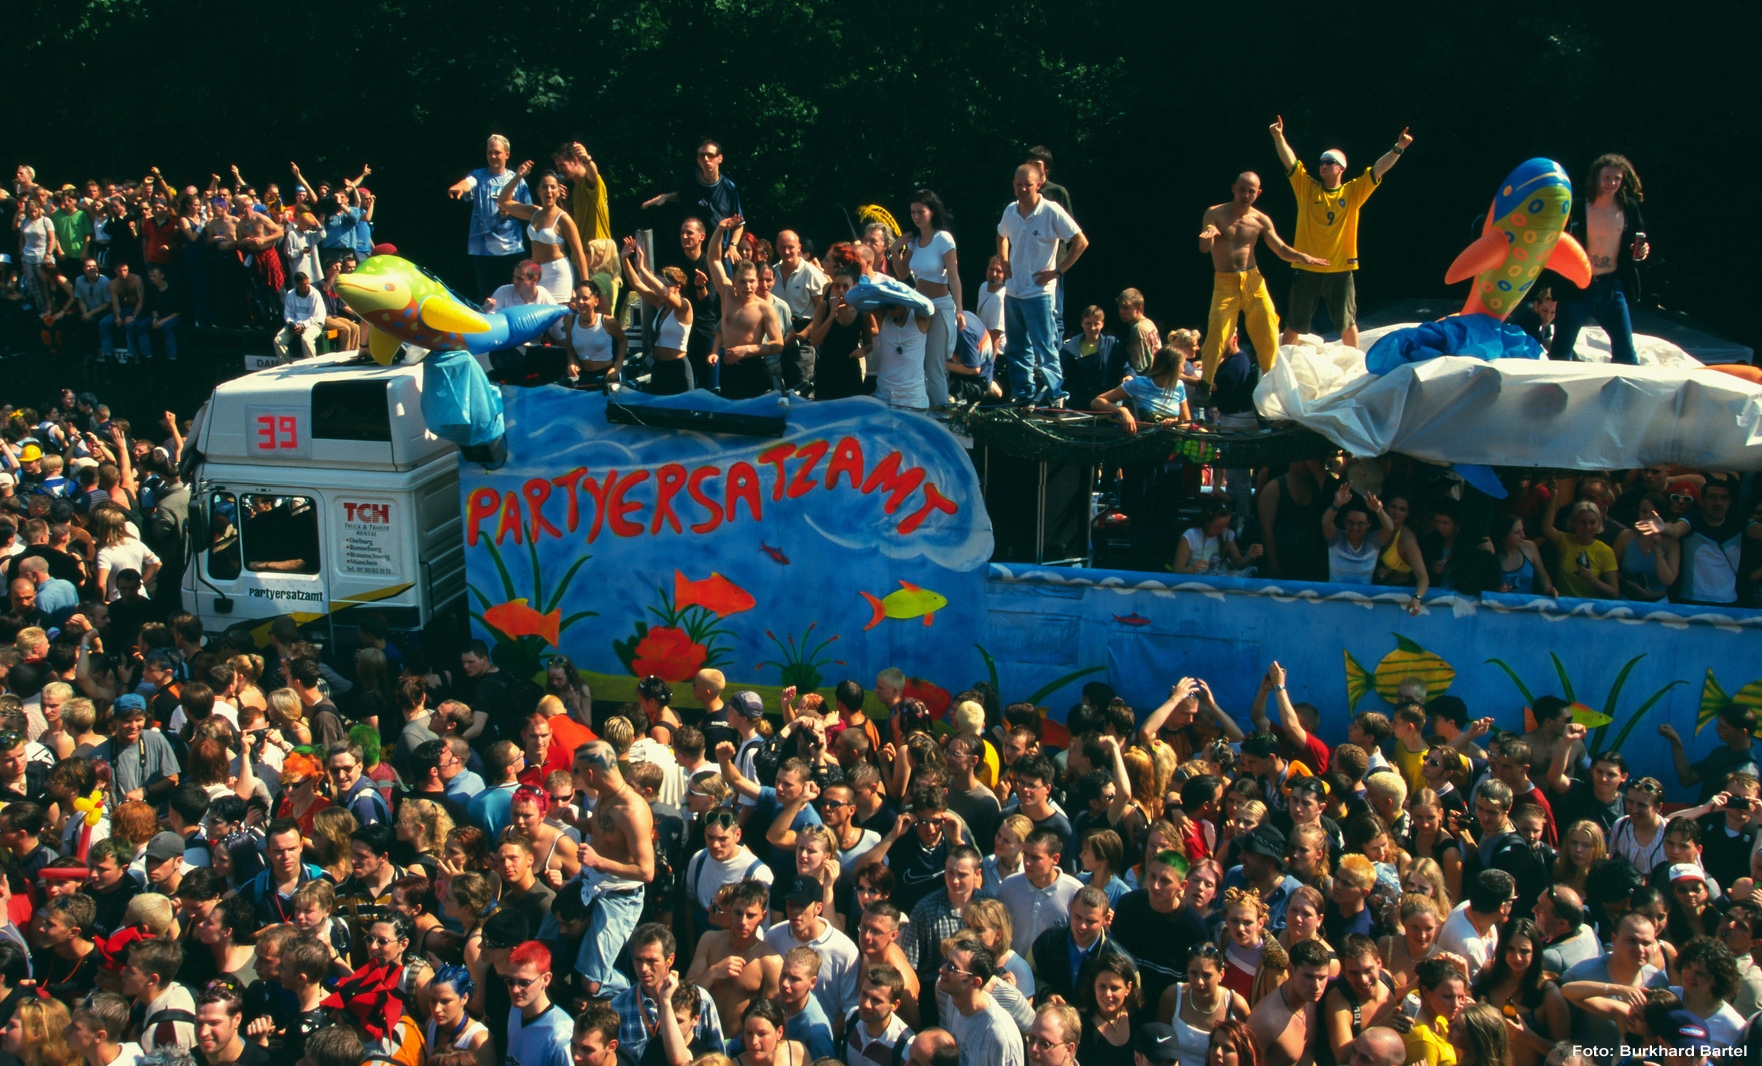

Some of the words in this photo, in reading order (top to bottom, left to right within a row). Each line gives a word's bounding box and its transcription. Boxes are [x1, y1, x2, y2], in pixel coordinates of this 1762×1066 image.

[1327, 211, 1335, 226] 9
[257, 415, 298, 449] 39
[466, 437, 958, 546] PARTYERSATZAMT
[343, 502, 389, 524] TCH
[249, 587, 323, 602] Partyersatzamt
